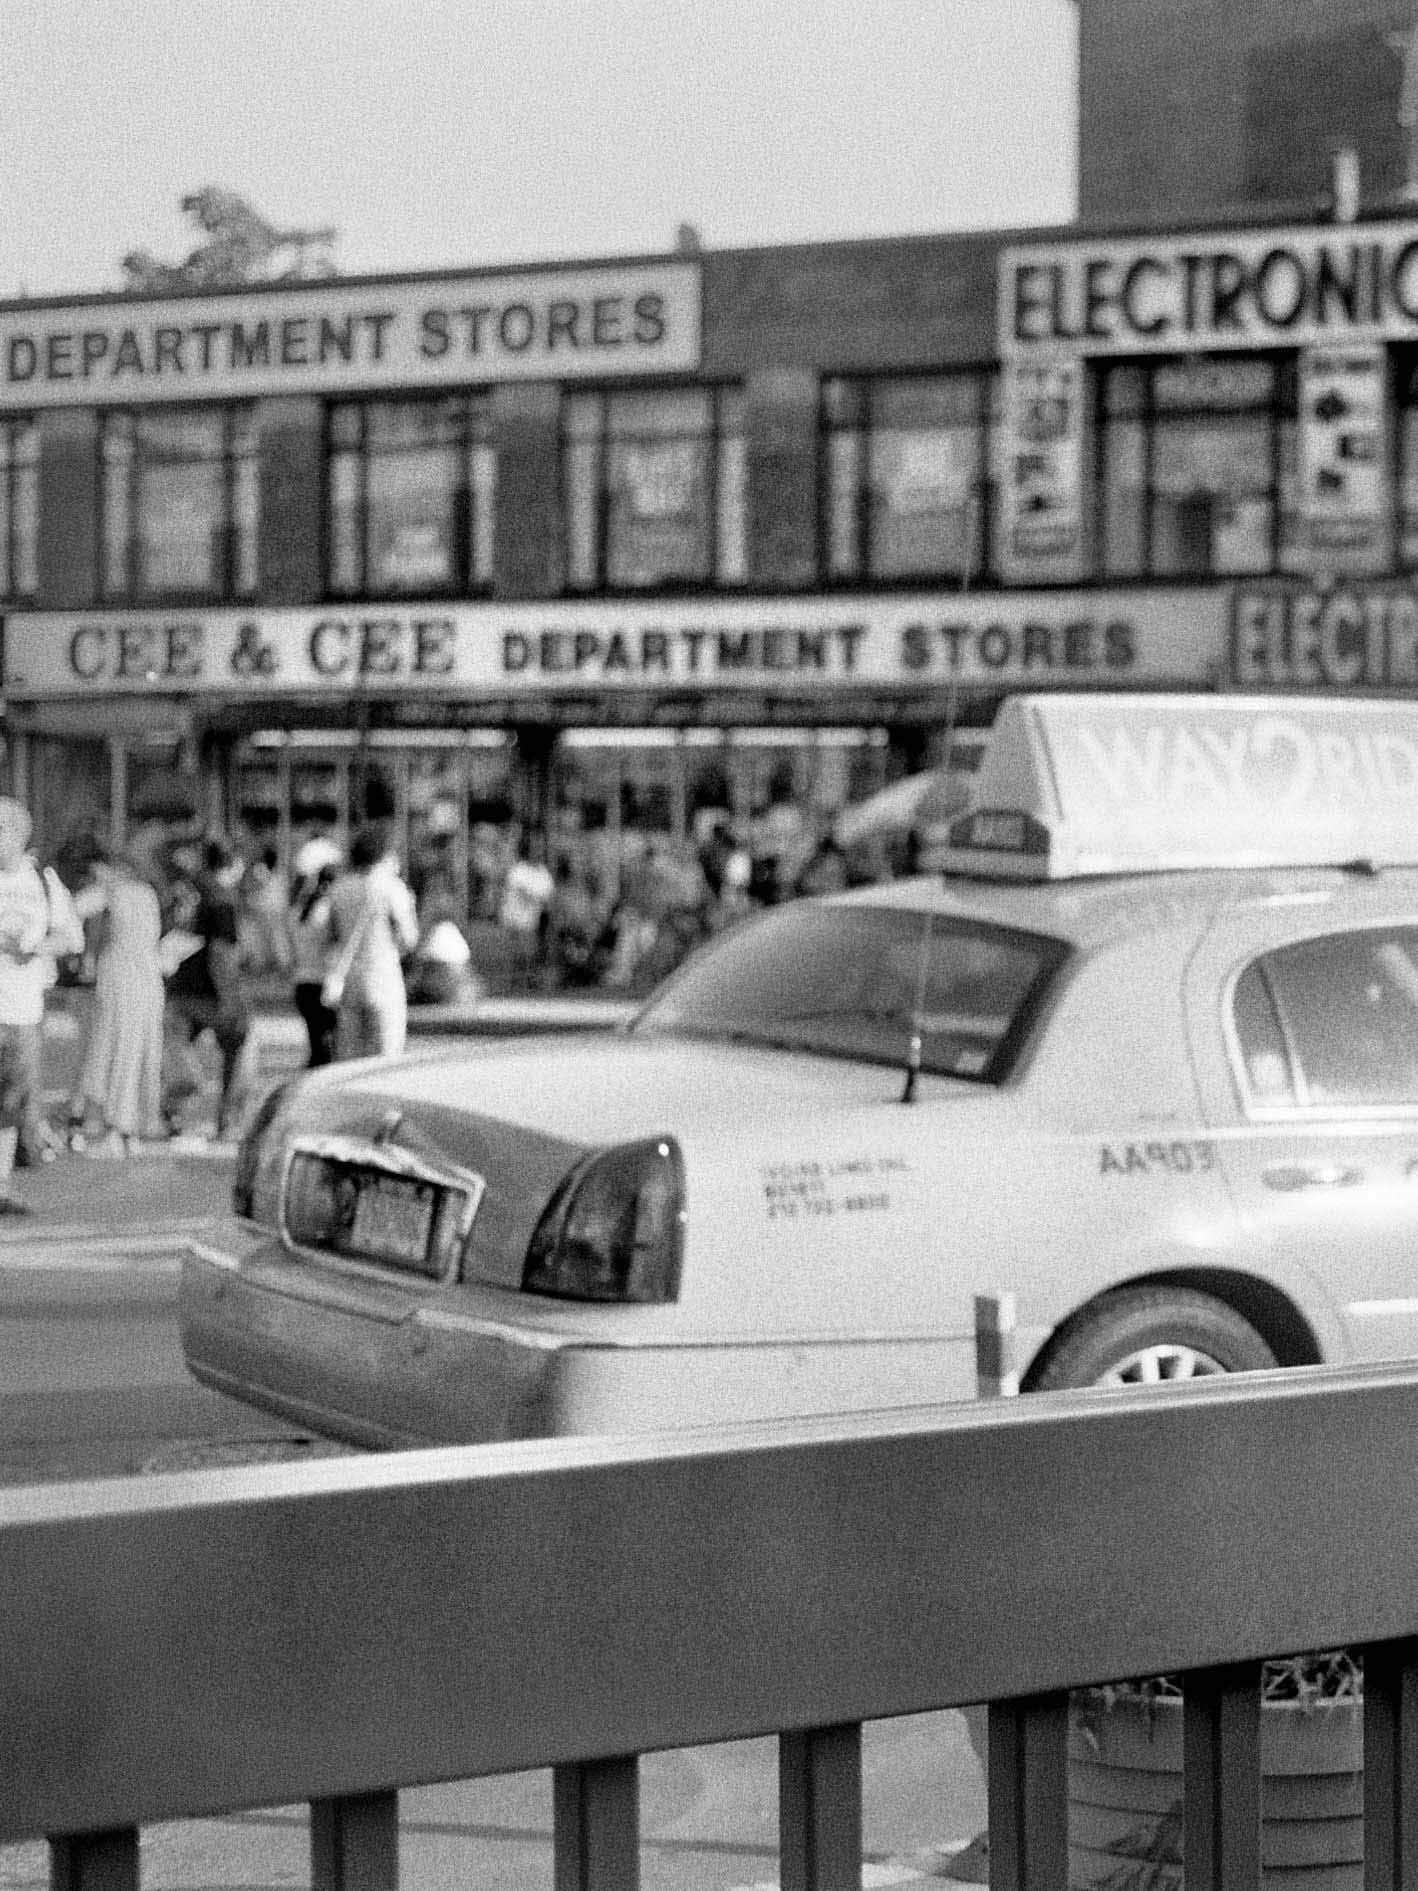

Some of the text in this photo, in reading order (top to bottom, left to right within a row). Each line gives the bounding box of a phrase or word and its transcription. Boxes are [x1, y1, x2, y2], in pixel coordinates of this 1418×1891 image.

[7, 289, 669, 382] DEPARTMENT STORES
[68, 617, 456, 680] CEE & CEE
[501, 619, 1136, 673] DEPARTMENT STORES
